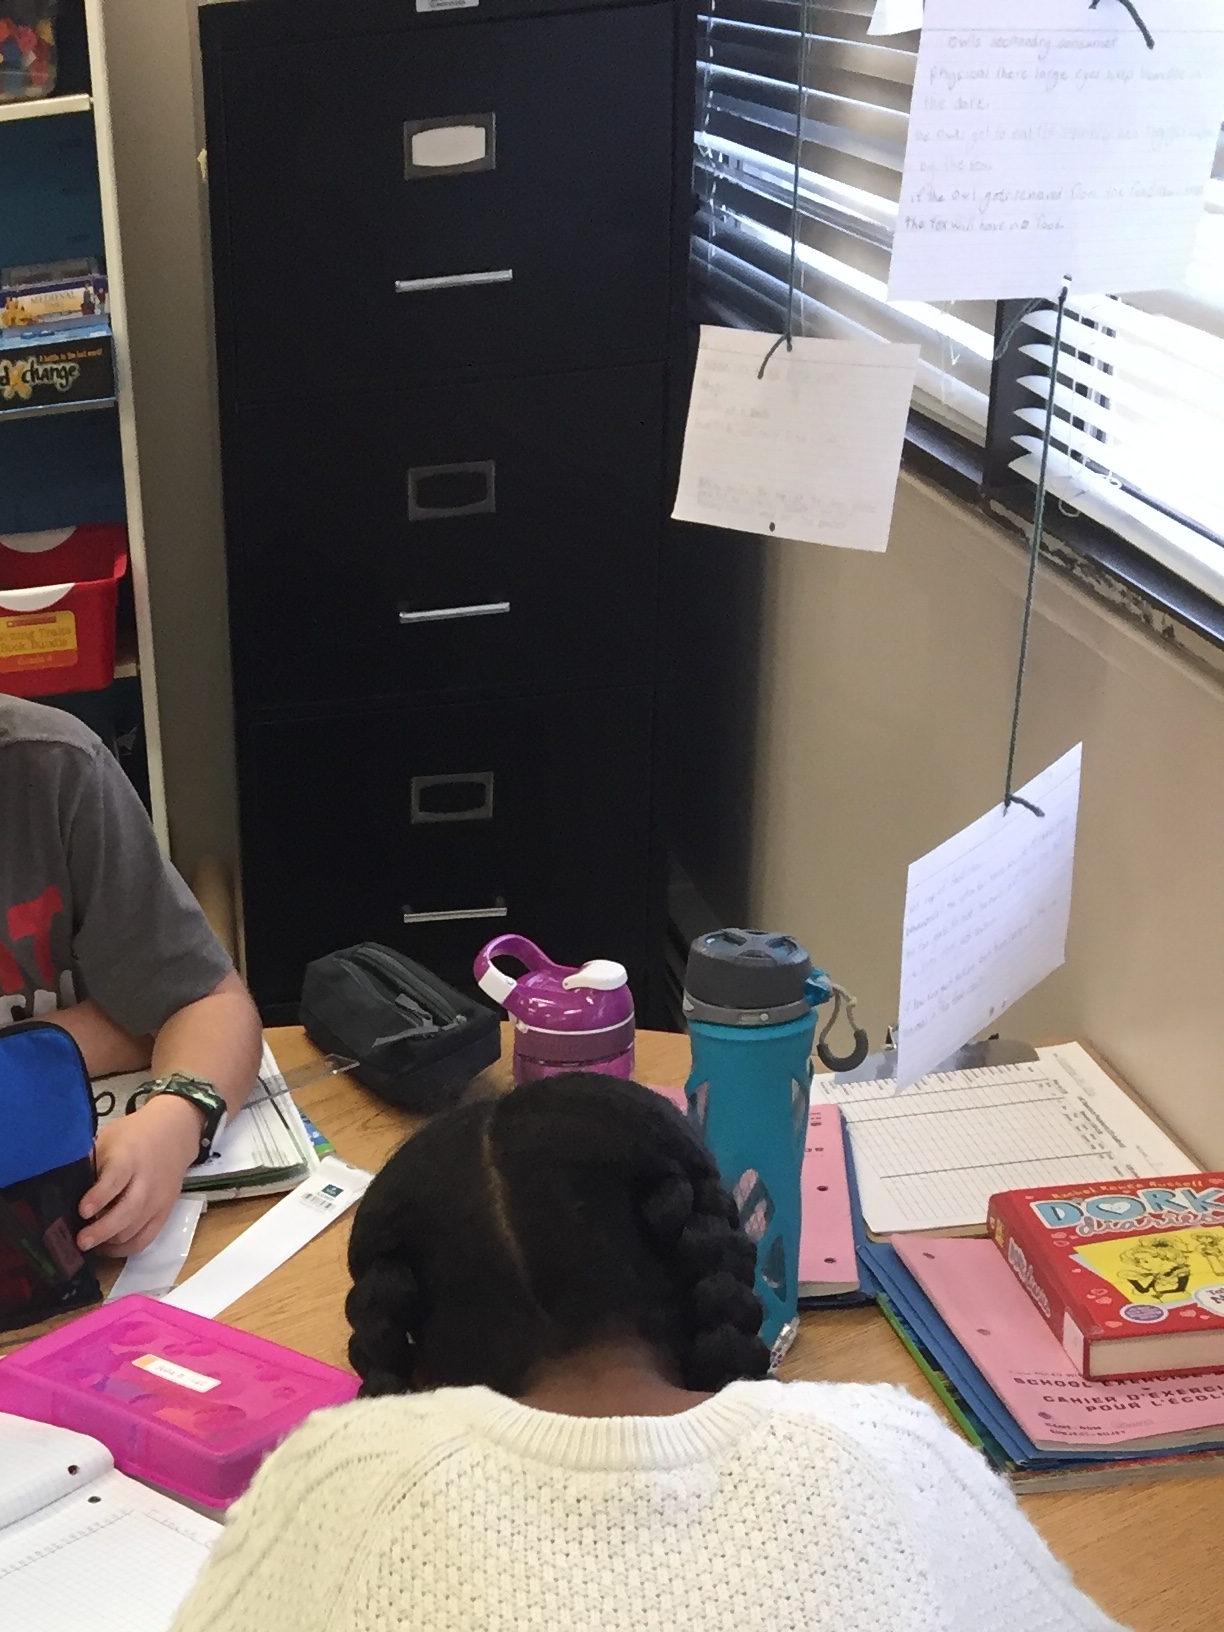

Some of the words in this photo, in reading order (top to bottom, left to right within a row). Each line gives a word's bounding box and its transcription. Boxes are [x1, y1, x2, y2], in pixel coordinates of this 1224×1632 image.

[1030, 1188, 1224, 1229] DORK
[1014, 1377, 1093, 1388] SCHOOL
[1043, 1395, 1118, 1405] CAHIER
[1086, 1401, 1142, 1413] POUR
